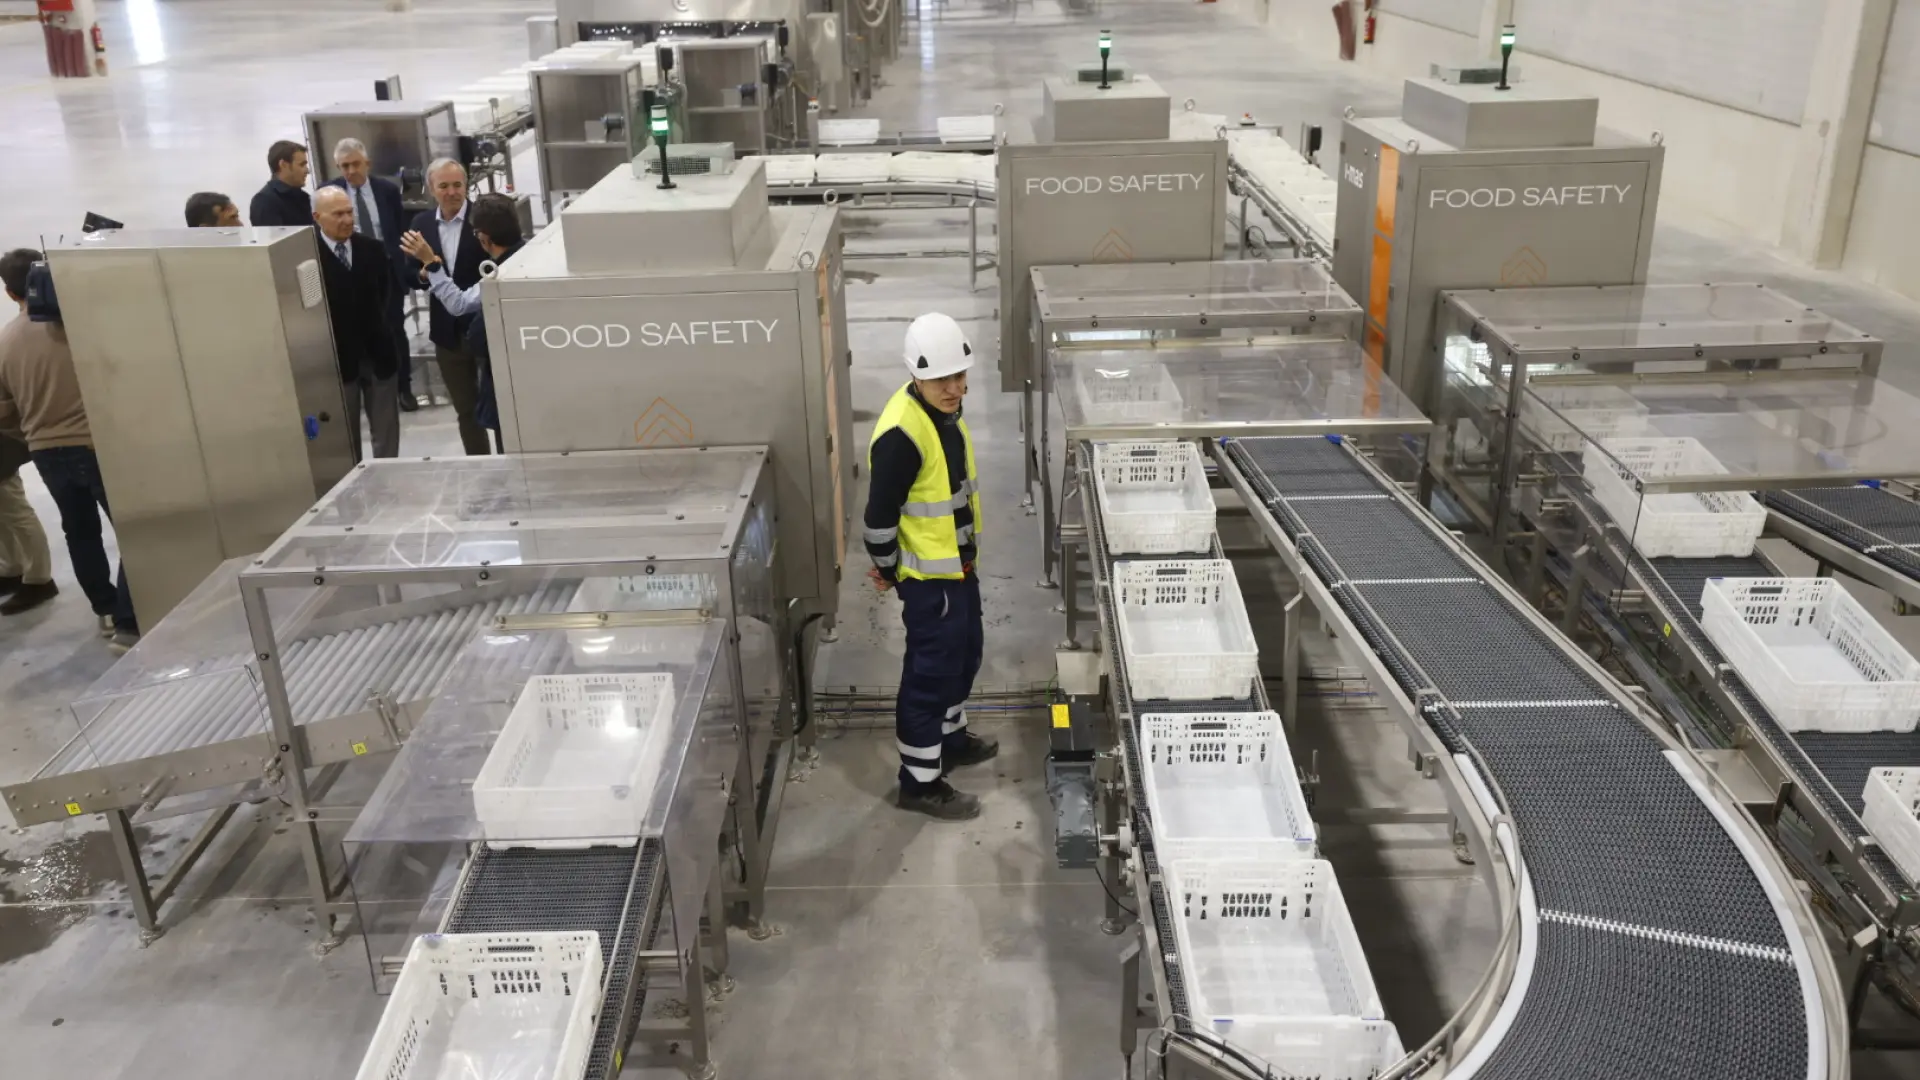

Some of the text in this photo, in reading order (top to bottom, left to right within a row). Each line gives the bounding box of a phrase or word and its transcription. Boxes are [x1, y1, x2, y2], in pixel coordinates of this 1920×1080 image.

[1026, 173, 1205, 195] FOOD SAFETY
[1429, 184, 1631, 208] FOOD SAFETY
[519, 319, 778, 350] FOOD SAFETY
